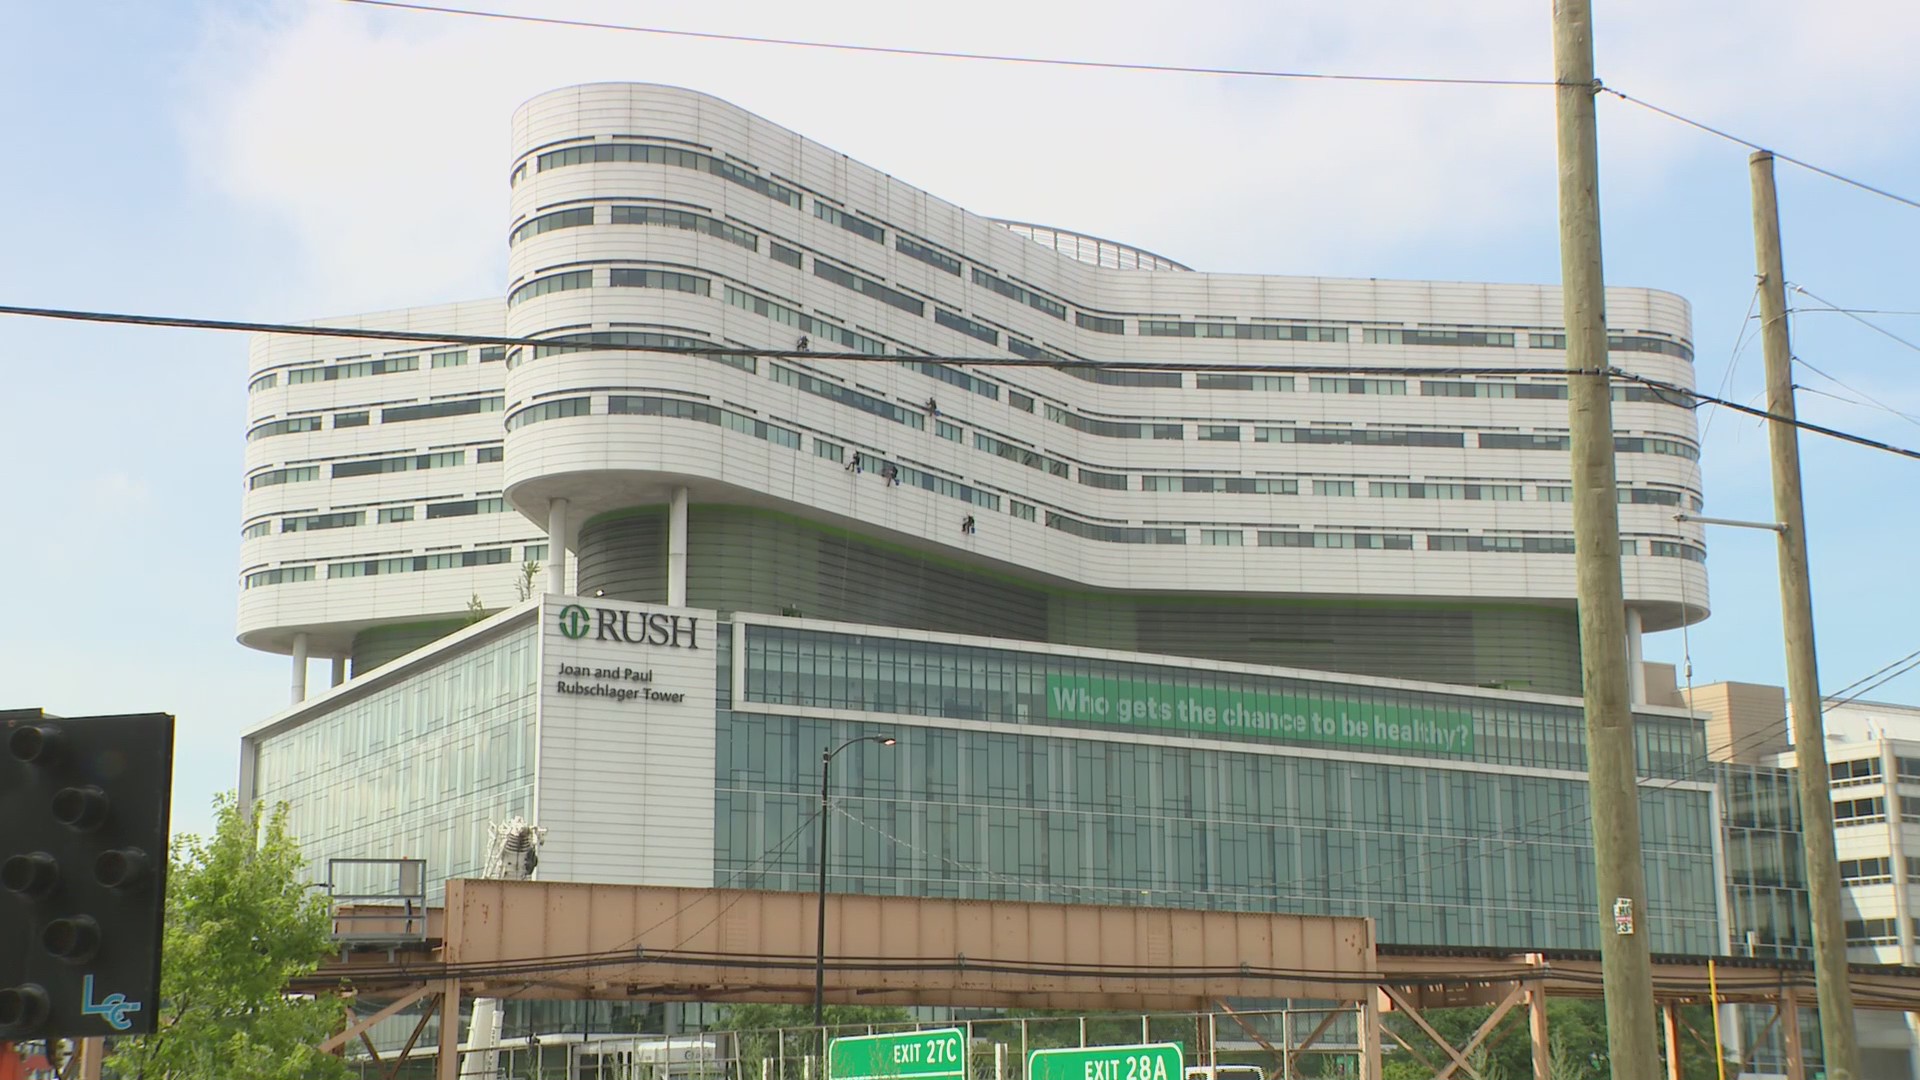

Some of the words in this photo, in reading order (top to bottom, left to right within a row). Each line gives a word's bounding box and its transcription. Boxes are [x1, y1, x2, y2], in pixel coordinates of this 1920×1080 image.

[596, 608, 698, 649] RUSH
[559, 663, 590, 677] Joan
[594, 666, 620, 680] and
[624, 668, 653, 682] Paul
[557, 681, 639, 701] Rubschlager
[643, 688, 685, 703] Tower
[1053, 686, 1110, 716] Who
[1117, 697, 1173, 723] gets
[1177, 698, 1217, 724] the
[1222, 702, 1307, 733] chance
[1311, 712, 1336, 735] to
[1341, 712, 1369, 738] be
[1374, 714, 1469, 751] healthy?
[893, 1043, 921, 1063] EXIT
[926, 1038, 957, 1063] 27C
[1084, 1059, 1120, 1080] EXIT
[1126, 1055, 1167, 1080] 28A
